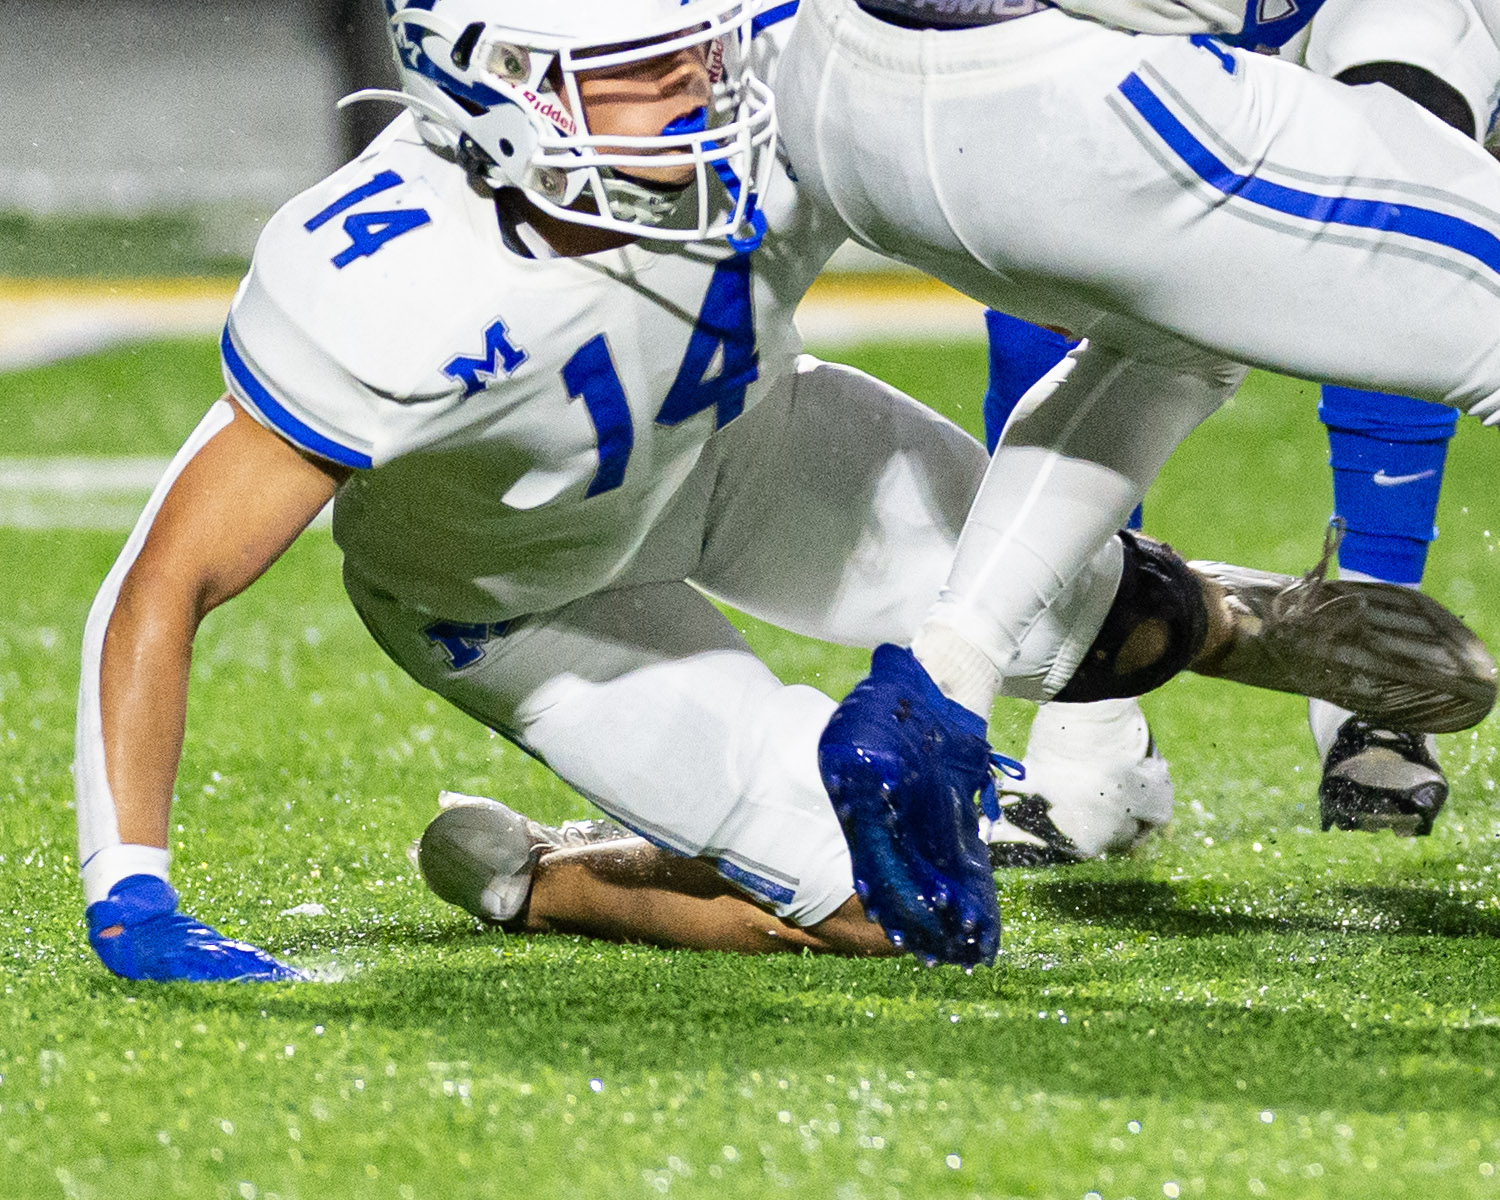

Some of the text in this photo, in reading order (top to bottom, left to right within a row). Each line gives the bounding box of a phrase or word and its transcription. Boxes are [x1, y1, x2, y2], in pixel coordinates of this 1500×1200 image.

[303, 169, 432, 270] 14
[438, 315, 530, 399] M
[560, 252, 762, 500] 14
